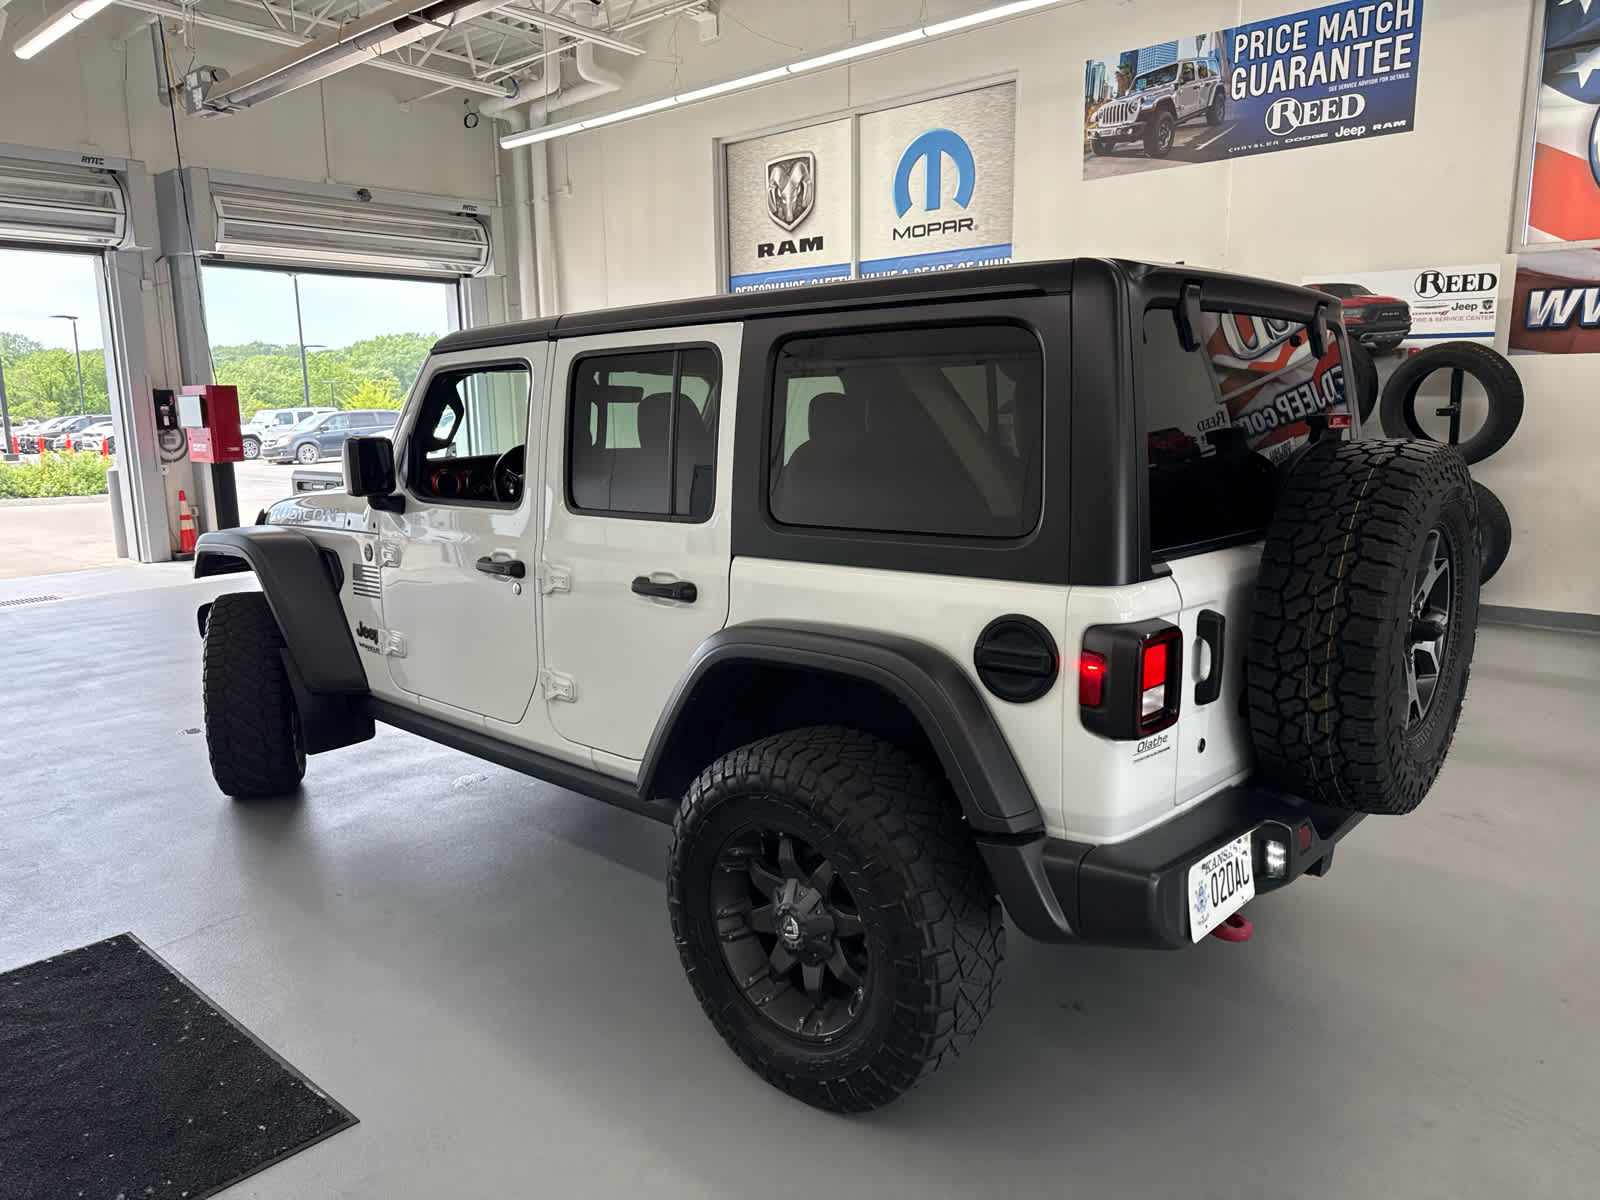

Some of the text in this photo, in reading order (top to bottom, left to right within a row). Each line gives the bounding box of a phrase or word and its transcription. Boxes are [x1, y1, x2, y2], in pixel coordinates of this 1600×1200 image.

[1234, 0, 1414, 63] PRICE MATCH
[1231, 32, 1415, 100] GUARANTEE
[1379, 75, 1389, 84] FOR
[1265, 93, 1366, 136] REED
[1228, 120, 1407, 153] CHRYSLER DODGE Jeep RAM
[892, 217, 975, 241] MOPAR
[757, 236, 824, 258] RAM
[1414, 270, 1497, 298] REED
[1451, 302, 1478, 312] Jeep
[356, 620, 379, 645] Jeep
[1137, 735, 1168, 753] Olathe
